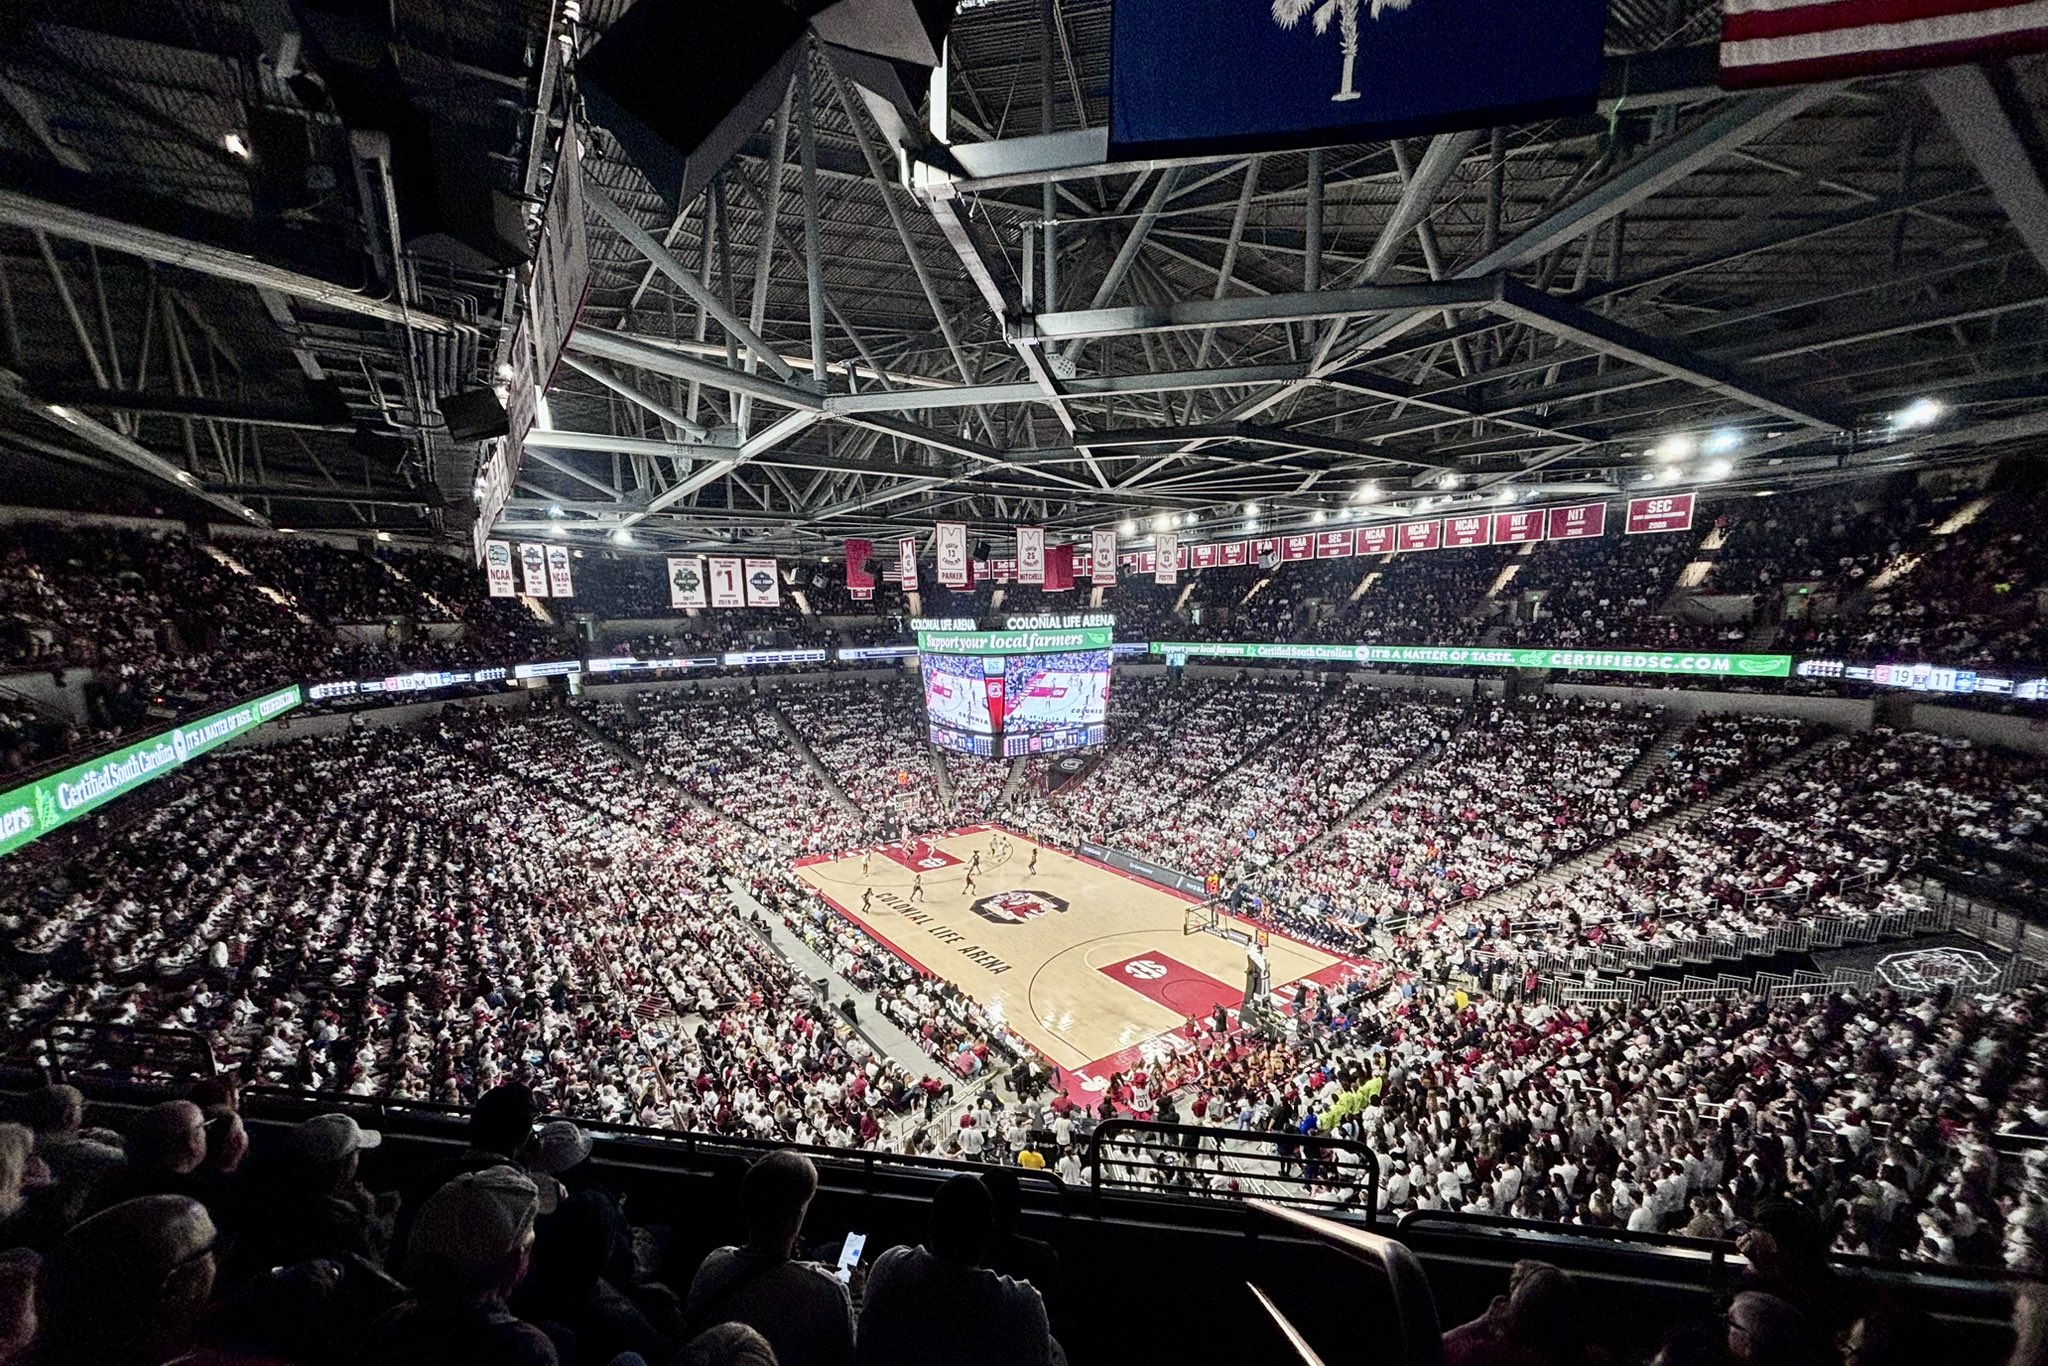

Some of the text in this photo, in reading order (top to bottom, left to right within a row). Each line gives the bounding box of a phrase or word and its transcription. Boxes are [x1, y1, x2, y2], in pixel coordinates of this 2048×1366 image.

[1648, 499, 1672, 513] SEC
[1511, 514, 1527, 526] NIT
[1568, 508, 1586, 520] NIT
[1408, 524, 1430, 536] NCAA
[1455, 519, 1479, 531] NCAA
[1328, 534, 1342, 543] SEC
[1365, 528, 1385, 540] NCAA
[1289, 537, 1307, 548] NCAA
[490, 569, 511, 580] NCAA
[552, 573, 570, 582] NCAA
[941, 572, 963, 580] PARKER
[911, 618, 977, 631] COLONIAL LIFE ARENA
[1007, 614, 1115, 630] COLONIAL LIFE ARENA
[926, 633, 1083, 651] Support your local farmers
[1257, 646, 1290, 656] Certified
[1291, 647, 1315, 657] South
[1316, 648, 1353, 658] Carolina
[1391, 649, 1401, 659] A
[1403, 649, 1448, 660] MATTER
[1450, 650, 1465, 661] OF
[1471, 651, 1515, 663] TASTE.
[1551, 653, 1730, 671] CERTIFIEDSC.COM
[401, 676, 438, 688] 19 11
[1894, 669, 1950, 686] 19 11
[1042, 733, 1077, 748] 19 11
[0, 806, 33, 842] ers
[58, 764, 112, 810] Certified
[110, 755, 140, 786] South
[138, 742, 175, 773] Carolina
[875, 892, 1013, 975] COLONIAL LIFE ARENA
[1138, 1099, 1148, 1108] 01
